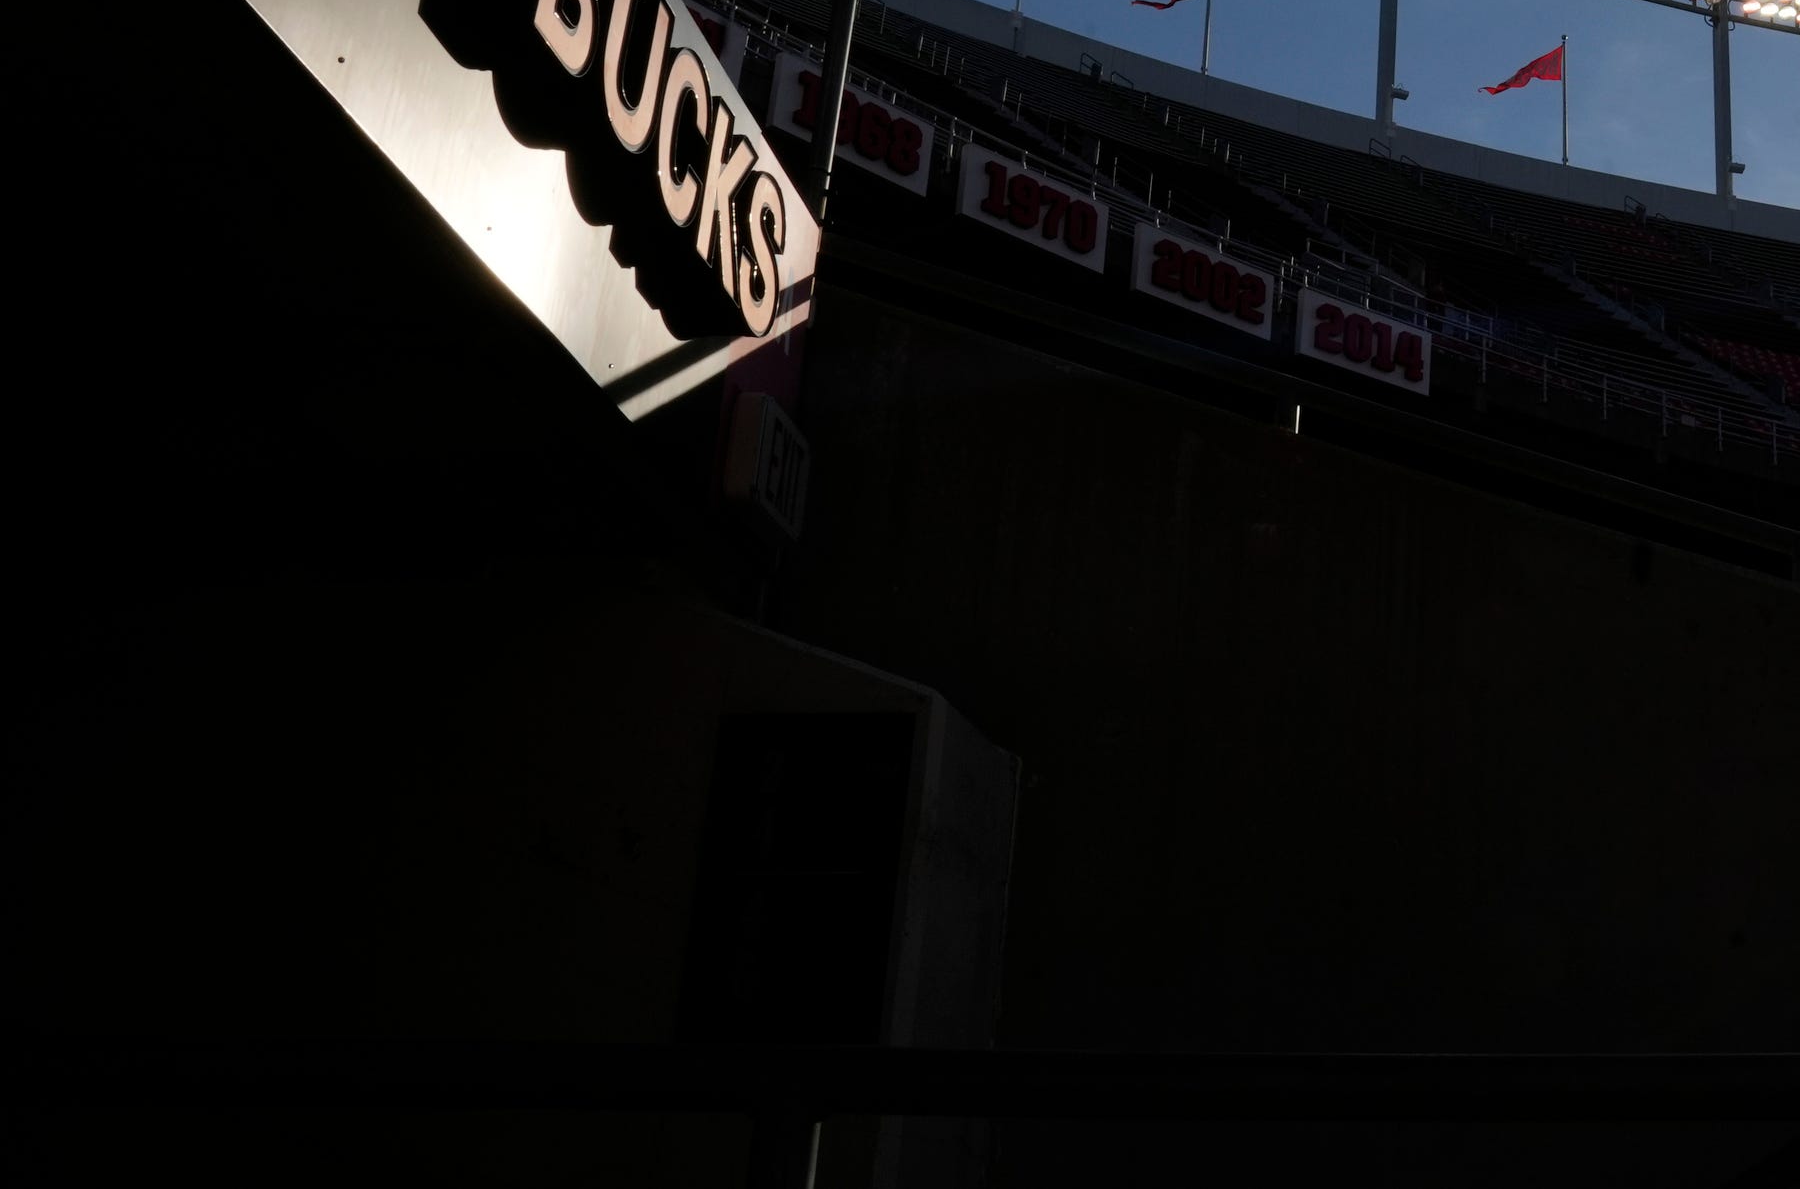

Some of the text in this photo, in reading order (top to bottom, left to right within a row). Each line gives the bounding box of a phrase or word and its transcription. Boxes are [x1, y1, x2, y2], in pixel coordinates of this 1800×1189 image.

[980, 160, 1099, 254] 1970
[1151, 238, 1266, 325] 2002
[1314, 302, 1424, 383] 2014
